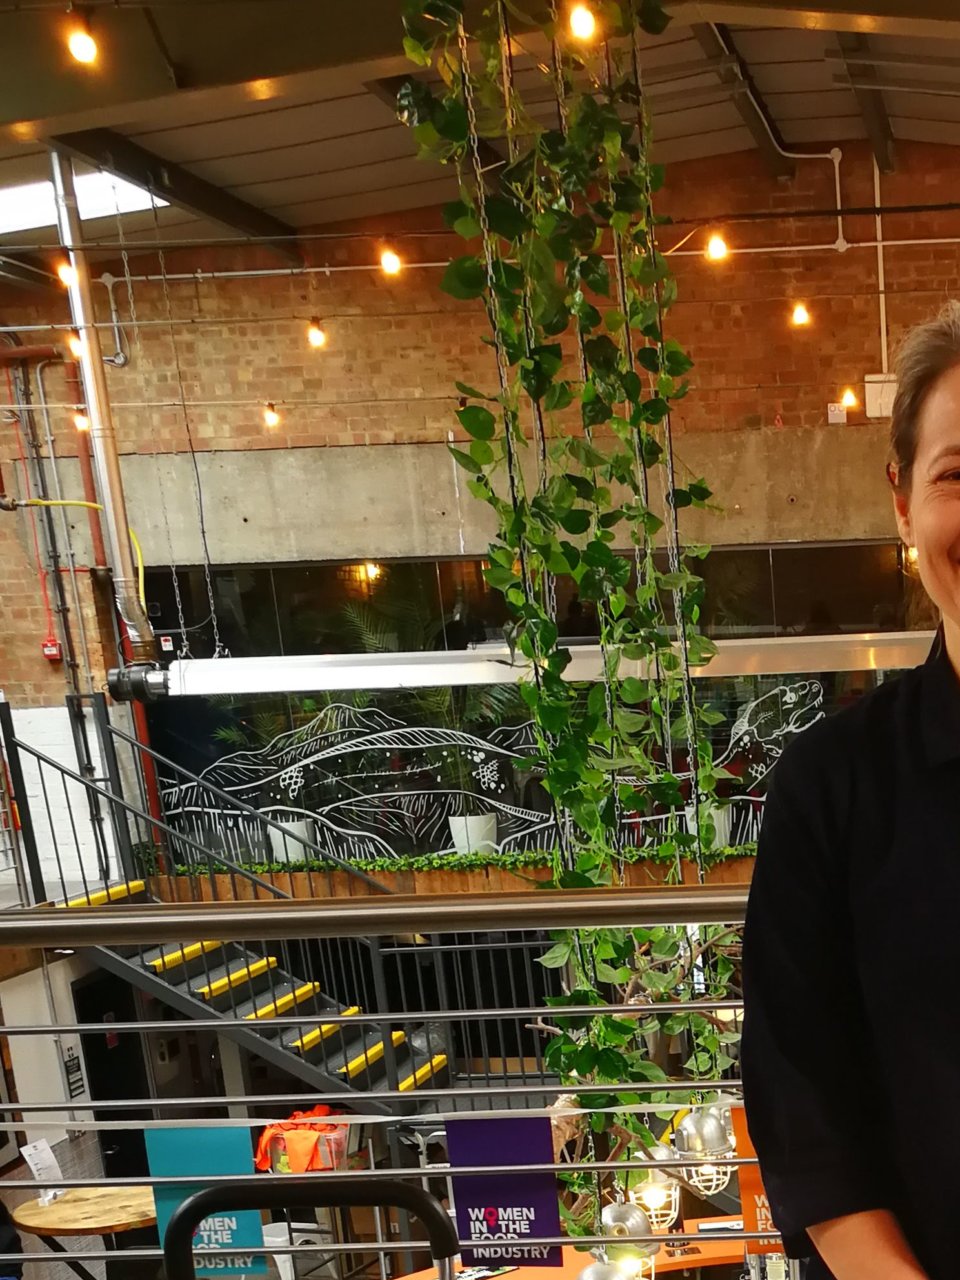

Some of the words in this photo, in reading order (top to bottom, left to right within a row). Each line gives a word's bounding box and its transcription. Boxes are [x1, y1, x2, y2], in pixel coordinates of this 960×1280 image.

[467, 1206, 535, 1221] WOMEN
[199, 1216, 238, 1231] MEN
[470, 1221, 488, 1233] IN
[498, 1220, 530, 1233] THE
[200, 1230, 233, 1243] THE
[473, 1246, 550, 1259] INDUSTRY
[193, 1255, 253, 1269] DUSTRY
